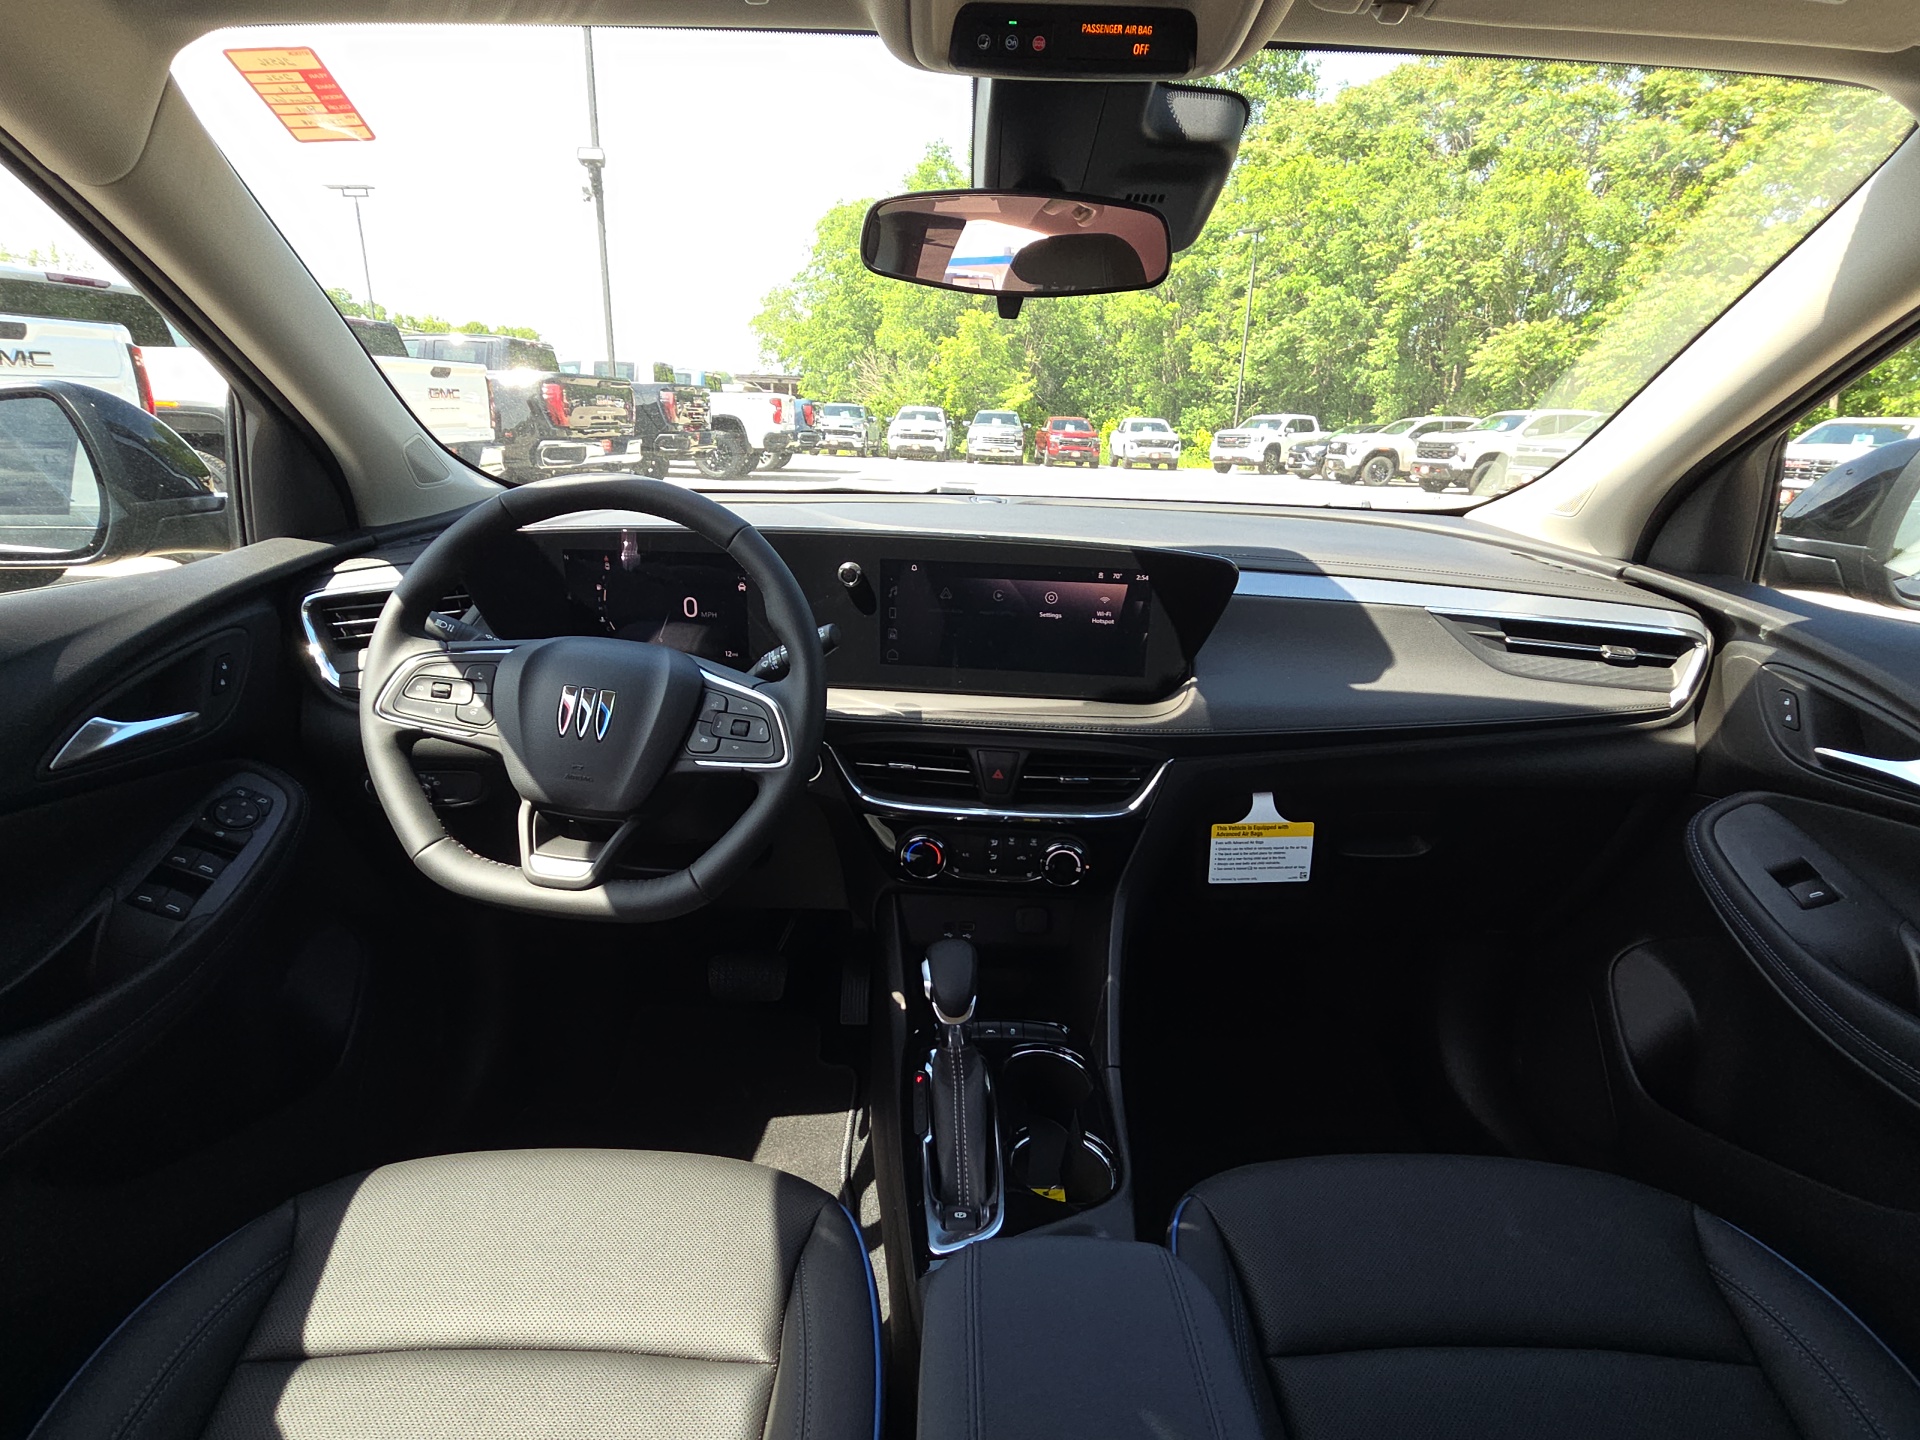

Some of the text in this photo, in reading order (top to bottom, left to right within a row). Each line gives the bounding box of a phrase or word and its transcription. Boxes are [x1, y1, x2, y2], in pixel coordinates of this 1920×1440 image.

[1081, 23, 1152, 35] PASSENGER AIR BAG
[1132, 43, 1150, 55] OFF
[0, 349, 55, 368] MC
[428, 387, 460, 400] GMC
[682, 596, 698, 618] 0
[1039, 611, 1062, 619] Settings
[1091, 618, 1115, 626] Hotspot
